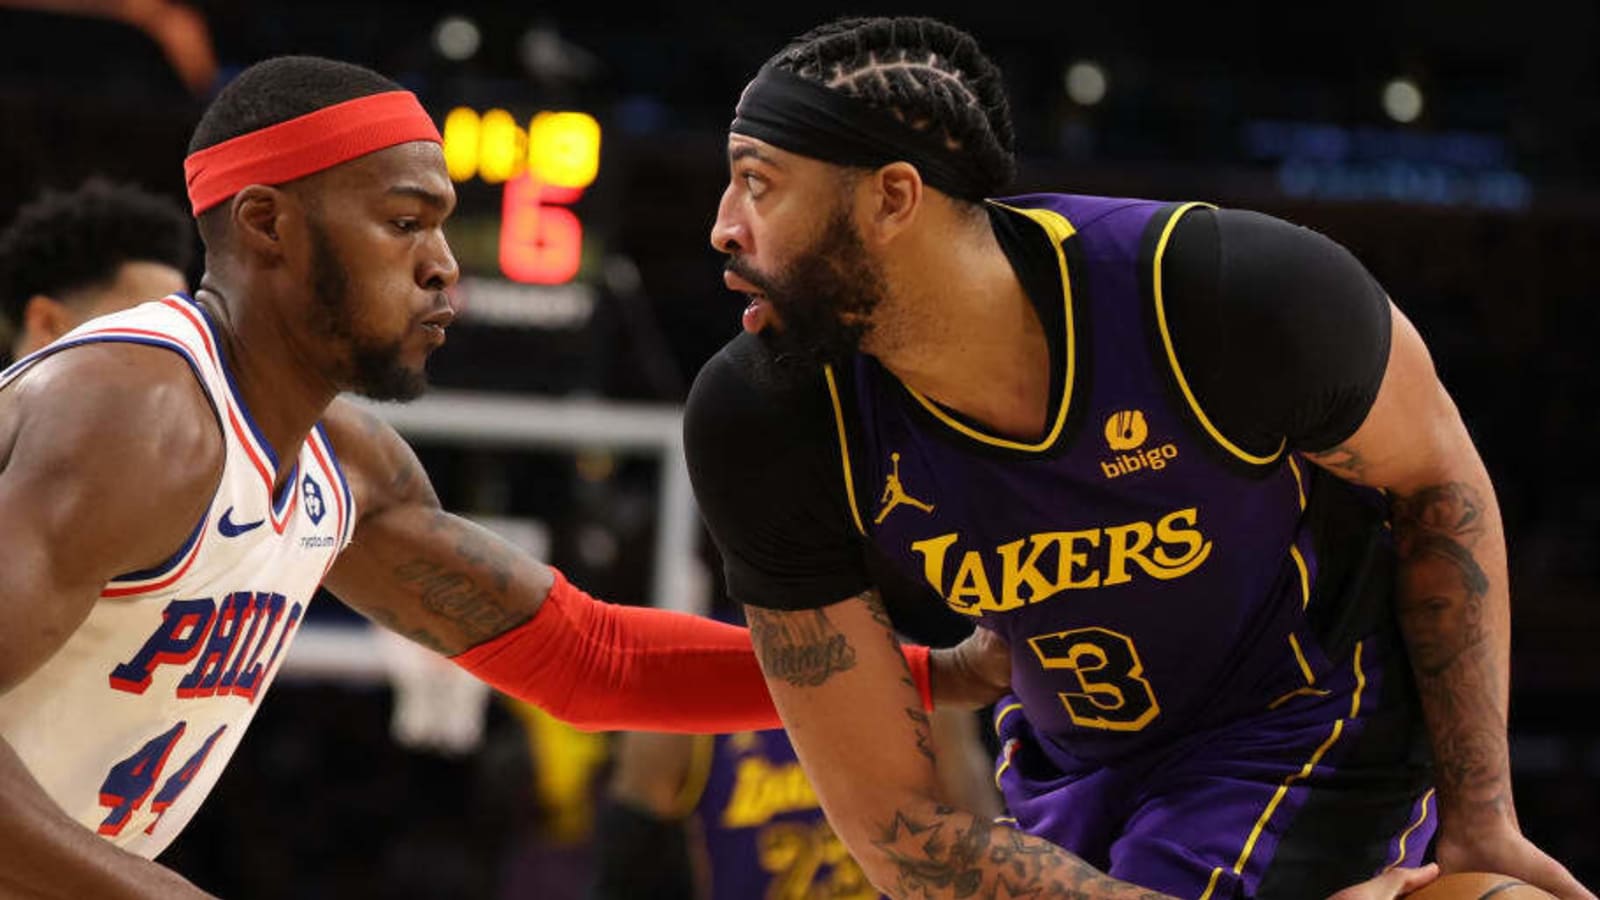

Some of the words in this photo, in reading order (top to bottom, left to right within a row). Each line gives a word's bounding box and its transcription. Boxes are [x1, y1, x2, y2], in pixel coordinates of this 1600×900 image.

[498, 170, 583, 286] 6
[1100, 443, 1179, 479] bibigo
[911, 507, 1213, 617] LAKERS
[1027, 626, 1161, 732] 3
[97, 720, 228, 836] 44
